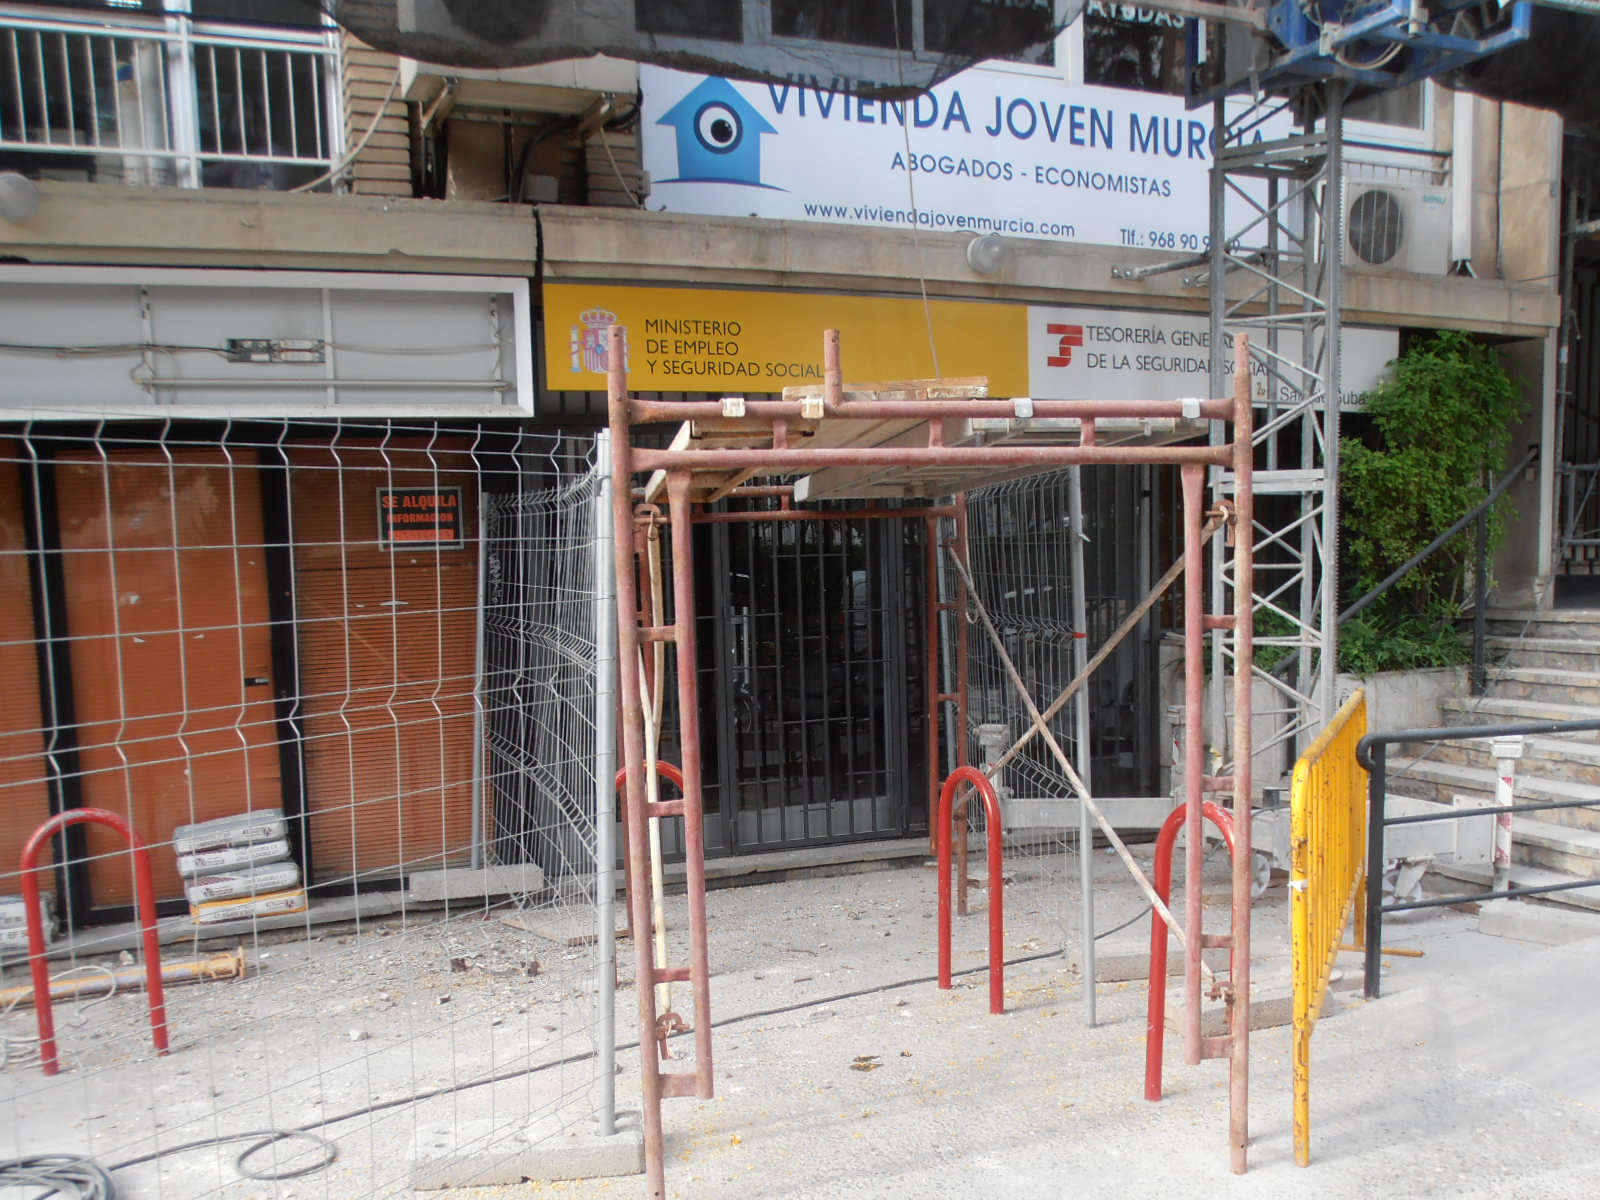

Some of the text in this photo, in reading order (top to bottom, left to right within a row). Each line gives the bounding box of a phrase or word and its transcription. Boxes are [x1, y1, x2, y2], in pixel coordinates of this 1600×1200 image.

[764, 72, 971, 133] VIVIENDA
[986, 96, 1113, 150] JOVEN
[891, 152, 1013, 181] ABOGADOS
[1035, 166, 1171, 197] ECONOMISTAS
[804, 203, 1075, 237] www.viviendajovenmurcia.com
[1149, 231, 1175, 248] 968
[1180, 234, 1198, 250] 90
[645, 319, 741, 336] MINISTERIO
[1086, 325, 1236, 349] TESORERÍA GENEL
[646, 339, 739, 356] DE EMPLEO
[646, 360, 825, 379] Y SEGURIDAD SOCIAL
[1087, 353, 1268, 377] DE LA SEGURIDA SIA
[382, 495, 457, 510] SE ALQULA
[387, 512, 453, 523] INFORMACON
